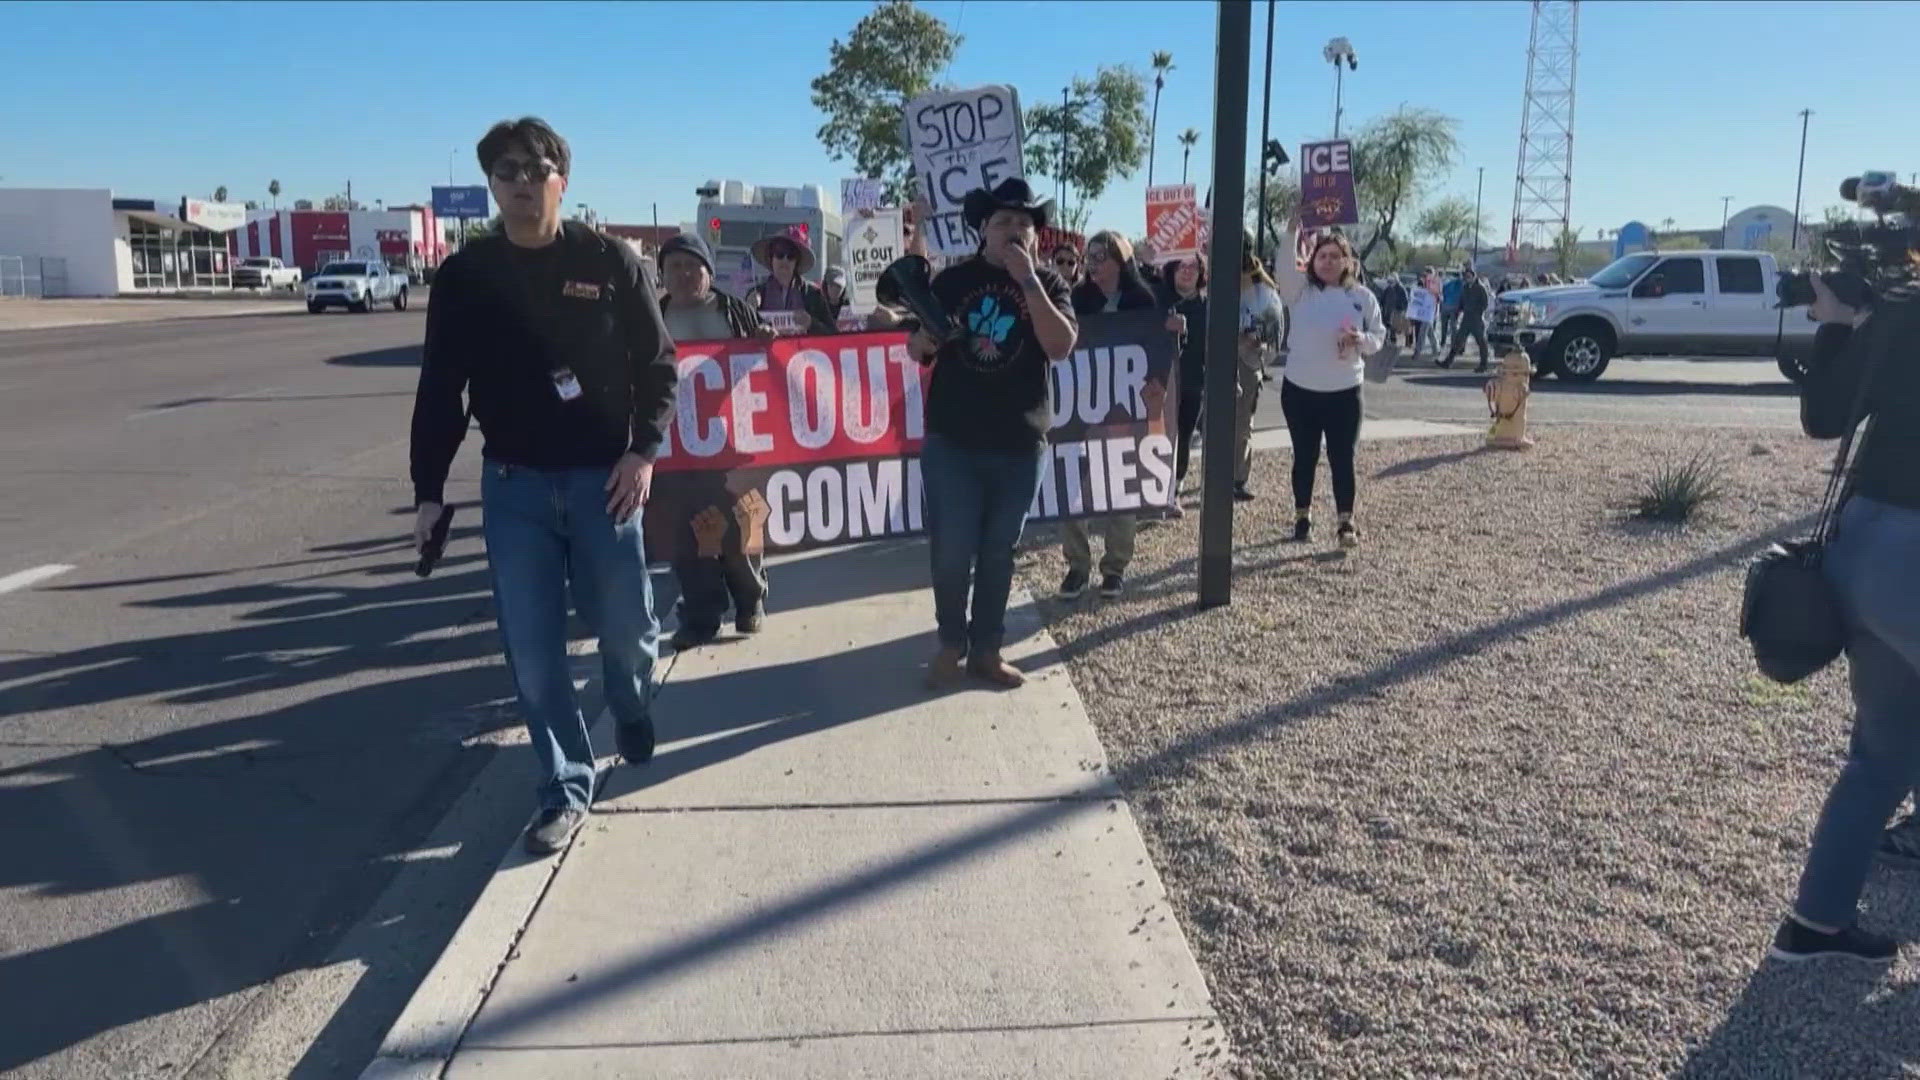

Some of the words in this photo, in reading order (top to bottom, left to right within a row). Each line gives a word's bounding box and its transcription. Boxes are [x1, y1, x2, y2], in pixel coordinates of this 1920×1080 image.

[917, 94, 1003, 149] STOP
[1303, 144, 1350, 174] ICE
[926, 157, 1008, 213] ICE
[1163, 188, 1181, 202] OUT
[375, 229, 408, 241] KFC
[925, 210, 979, 250] TER
[852, 247, 868, 264] ICE
[870, 246, 894, 261] OUT
[655, 353, 774, 458] CE
[786, 345, 925, 450] OUT
[1047, 344, 1148, 430] OUR
